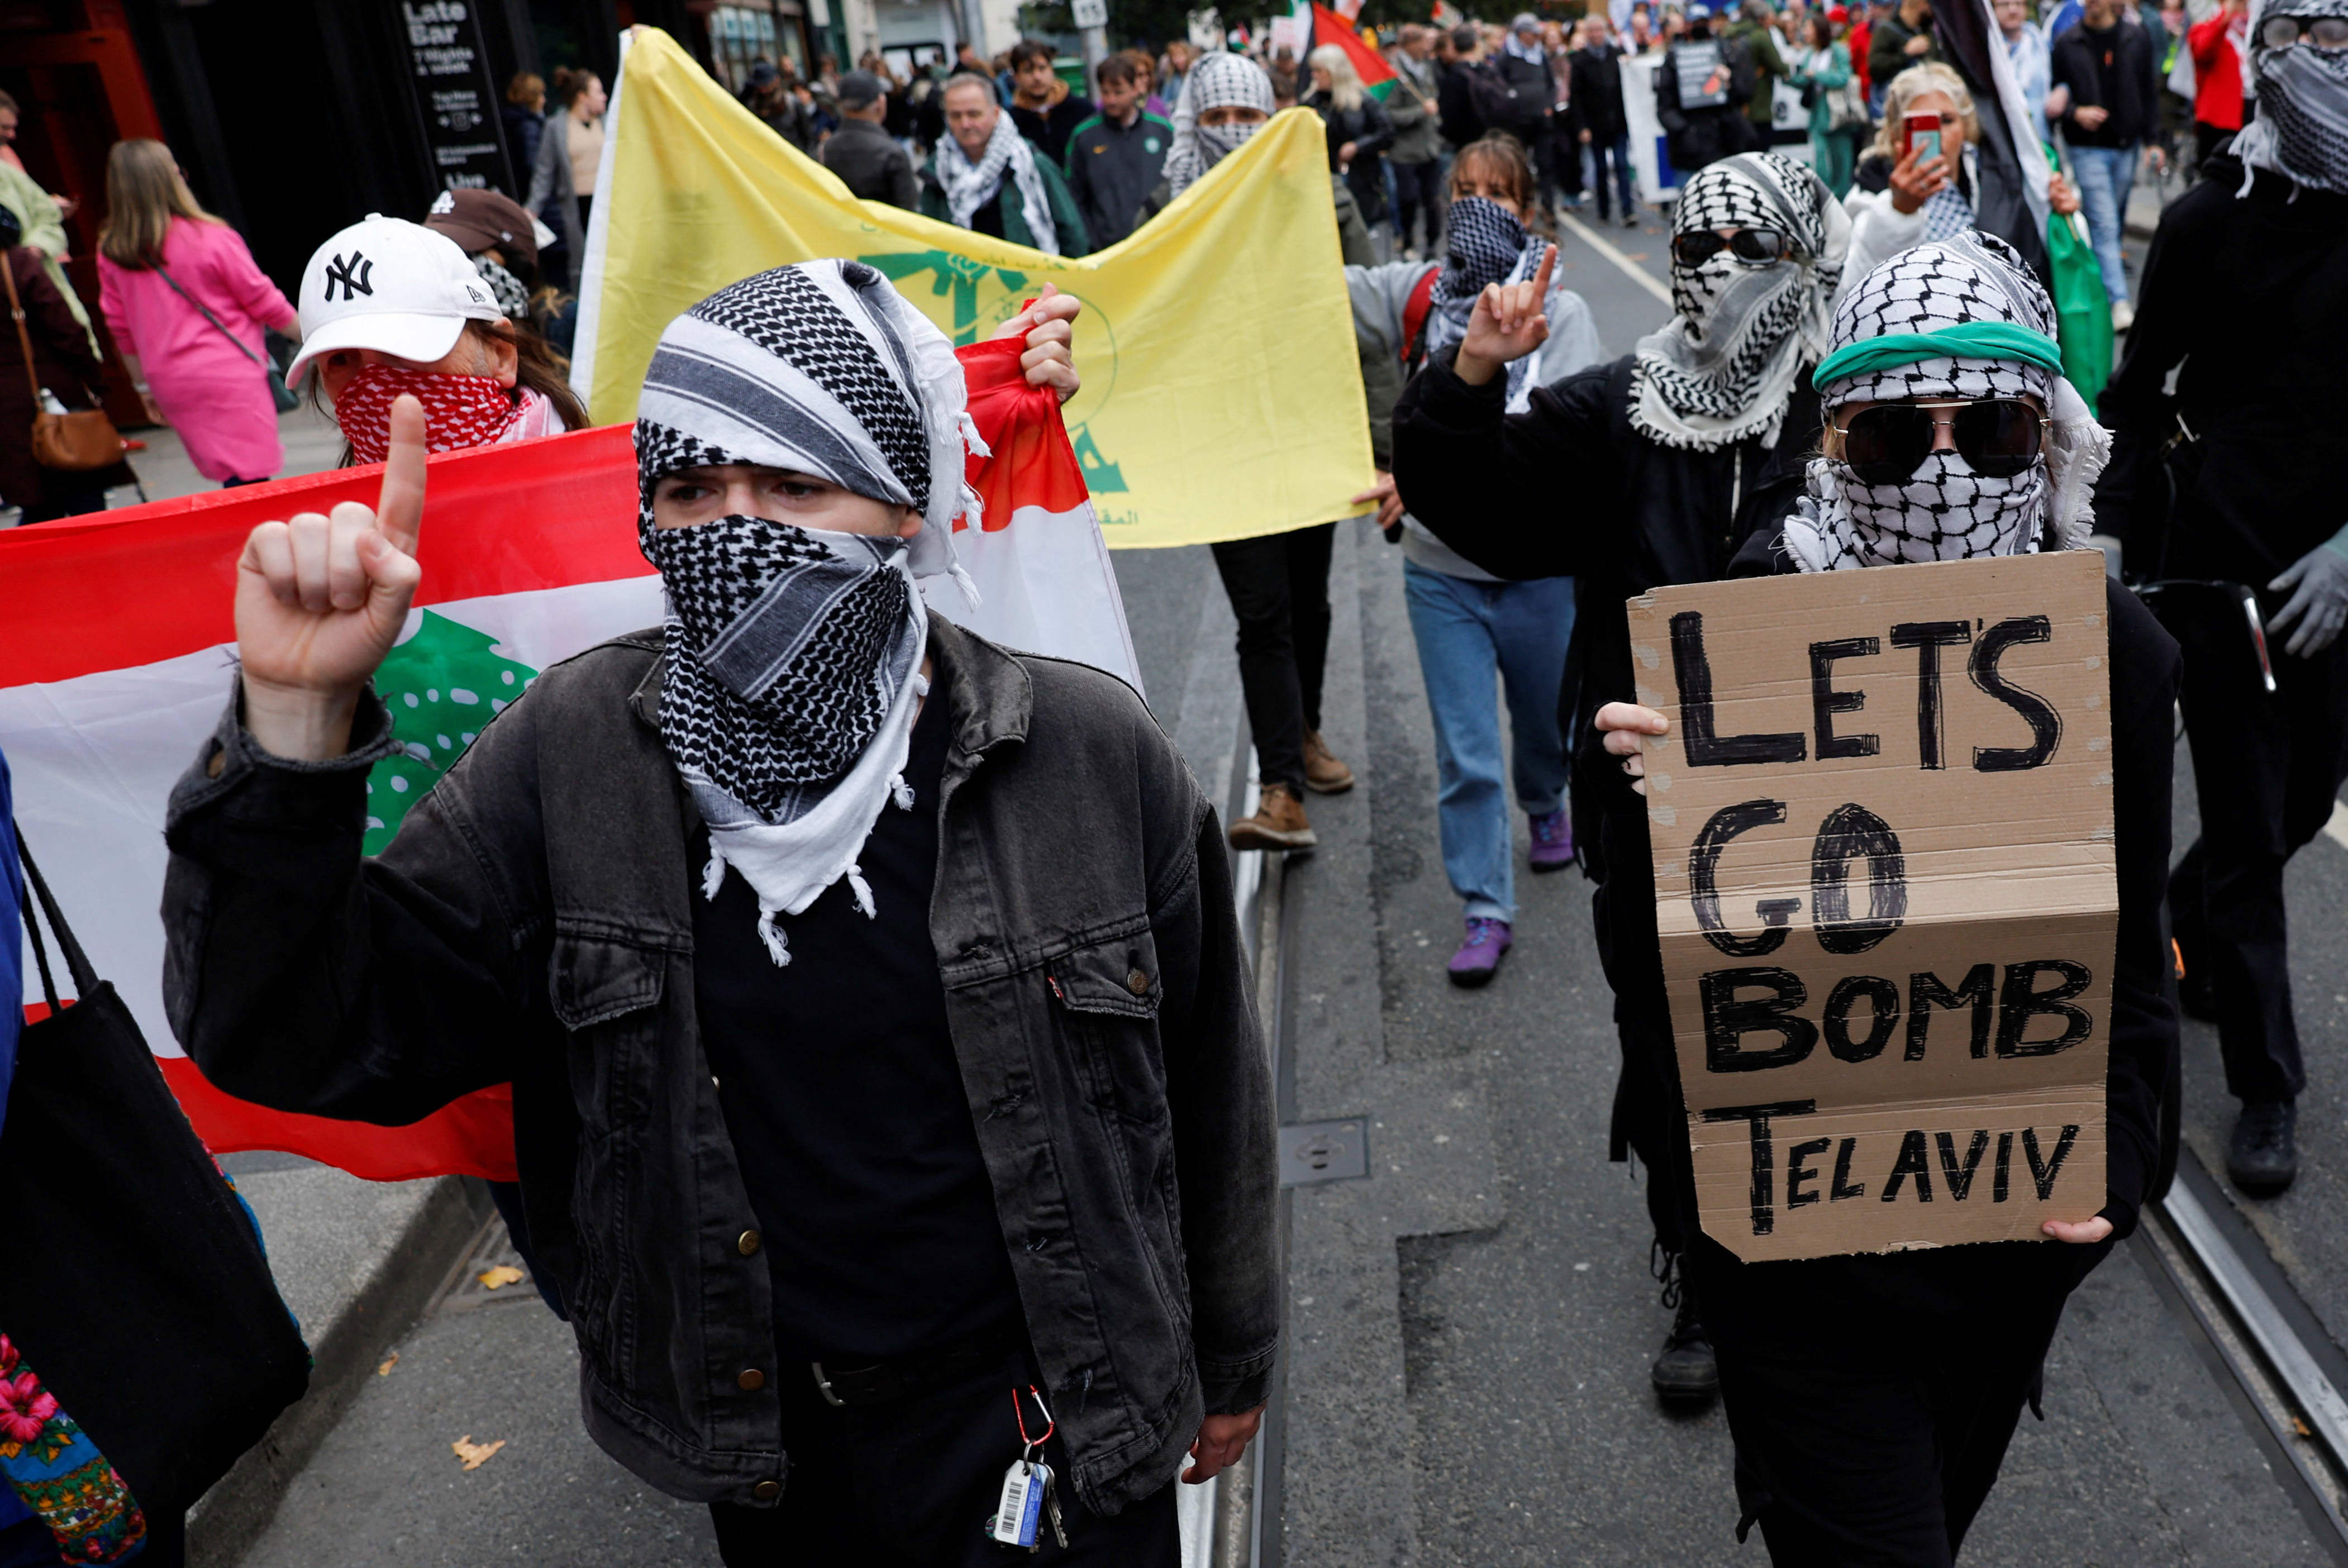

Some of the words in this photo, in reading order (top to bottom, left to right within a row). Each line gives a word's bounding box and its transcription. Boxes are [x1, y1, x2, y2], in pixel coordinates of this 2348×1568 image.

[402, 1, 466, 24] Late
[408, 24, 459, 46] Bar
[424, 46, 475, 63] Nights
[445, 171, 486, 190] Live
[325, 250, 373, 302] NY
[1669, 611, 2063, 772] LET'S
[1689, 798, 1907, 957] GO
[1699, 959, 2093, 1073] BOMB
[1698, 1099, 1865, 1236] TEL
[1880, 1124, 2080, 1203] AVIV
